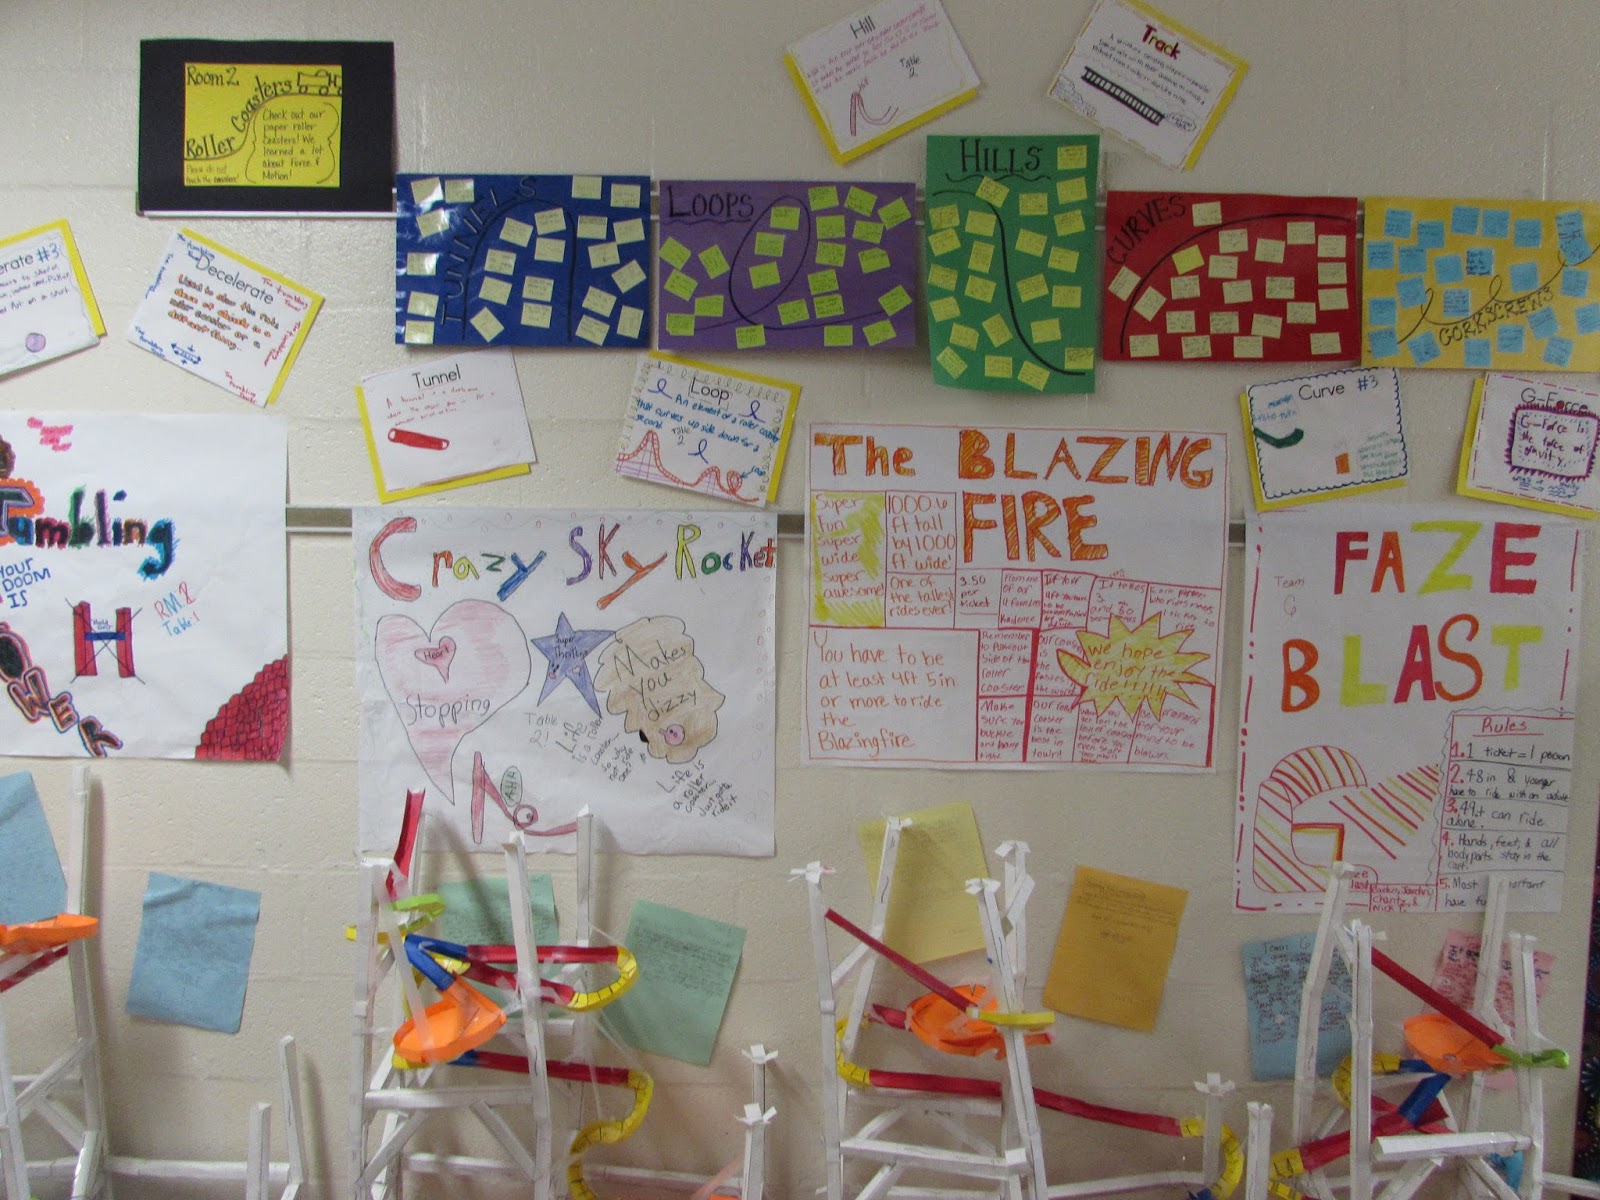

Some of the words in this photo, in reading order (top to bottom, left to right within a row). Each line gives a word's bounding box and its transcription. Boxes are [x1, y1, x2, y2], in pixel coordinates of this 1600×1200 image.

[850, 15, 875, 39] Hill
[1141, 24, 1181, 60] Track
[186, 65, 223, 86] Room
[226, 67, 240, 86] 2
[186, 134, 235, 159] Roller
[231, 75, 293, 133] Coasters
[262, 109, 288, 120] Check
[291, 108, 305, 119] out
[309, 110, 325, 119] our
[263, 122, 289, 138] paper
[292, 121, 316, 131] roller
[302, 134, 315, 144] We
[263, 145, 294, 156] learned
[312, 145, 323, 156] lot
[960, 138, 1043, 173] HILLS
[263, 157, 285, 168] about
[262, 171, 293, 181] Motion!
[667, 185, 755, 218] LOOPS
[1106, 194, 1188, 266] CURVES
[195, 253, 274, 304] Decelerate
[412, 364, 461, 388] Tunnel
[690, 376, 730, 405] Loop
[1298, 384, 1345, 401] Curve
[1357, 375, 1379, 392] #3
[676, 395, 689, 406] An
[1521, 387, 1588, 413] G-Force
[655, 409, 684, 422] curves
[688, 419, 700, 431] up
[701, 421, 716, 434] side
[718, 430, 740, 443] down
[677, 435, 685, 446] 2
[814, 432, 915, 477] The
[958, 428, 1213, 489] BLAZING
[816, 494, 861, 515] Super
[892, 516, 909, 533] ft
[914, 513, 943, 532] tall
[962, 491, 1109, 564] FIRE
[892, 536, 913, 556] by
[915, 534, 956, 551] 1000
[369, 516, 547, 602] Crazy
[821, 552, 859, 566] wide
[1333, 521, 1542, 595] FAZE
[2, 567, 51, 592] DOOM
[890, 576, 914, 589] One
[919, 575, 935, 587] of
[1274, 575, 1305, 588] Team
[7, 590, 29, 608] IS
[890, 591, 912, 603] the
[960, 597, 990, 607] ticket
[961, 589, 979, 599] per
[889, 605, 920, 617] rides
[554, 636, 576, 648] Super
[813, 630, 844, 663] You
[849, 643, 886, 663] have
[898, 643, 917, 665] to
[922, 651, 945, 666] be
[1122, 643, 1163, 659] hope
[424, 646, 450, 661] Heart
[612, 639, 688, 683] Makes
[1281, 613, 1543, 712] BLAST
[819, 669, 839, 689] at
[846, 671, 885, 688] least
[1093, 659, 1146, 677] enjoy
[1151, 665, 1176, 679] the
[647, 689, 698, 722] dizzy
[820, 696, 842, 708] or
[849, 696, 889, 709] more
[894, 694, 908, 706] to
[910, 695, 943, 709] ride
[405, 695, 492, 729] Stopping
[524, 712, 559, 727] Table
[821, 712, 856, 727] the
[1481, 717, 1527, 733] Rules
[555, 721, 588, 754] Life
[1485, 746, 1516, 758] ticket
[656, 768, 693, 794] Life
[1449, 764, 1465, 784] 2.
[684, 772, 705, 799] roller
[1449, 785, 1467, 796] have
[1468, 787, 1476, 796] to
[1485, 787, 1501, 799] ride
[1509, 790, 1526, 799] with
[1445, 797, 1458, 813] 3.
[1491, 811, 1511, 821] can
[1519, 810, 1544, 827] ride
[1541, 837, 1560, 848] all
[1500, 850, 1520, 862] stay
[1536, 852, 1550, 861] the
[1439, 877, 1450, 889] 5.
[1453, 877, 1478, 889] Most
[1445, 893, 1466, 907] have
